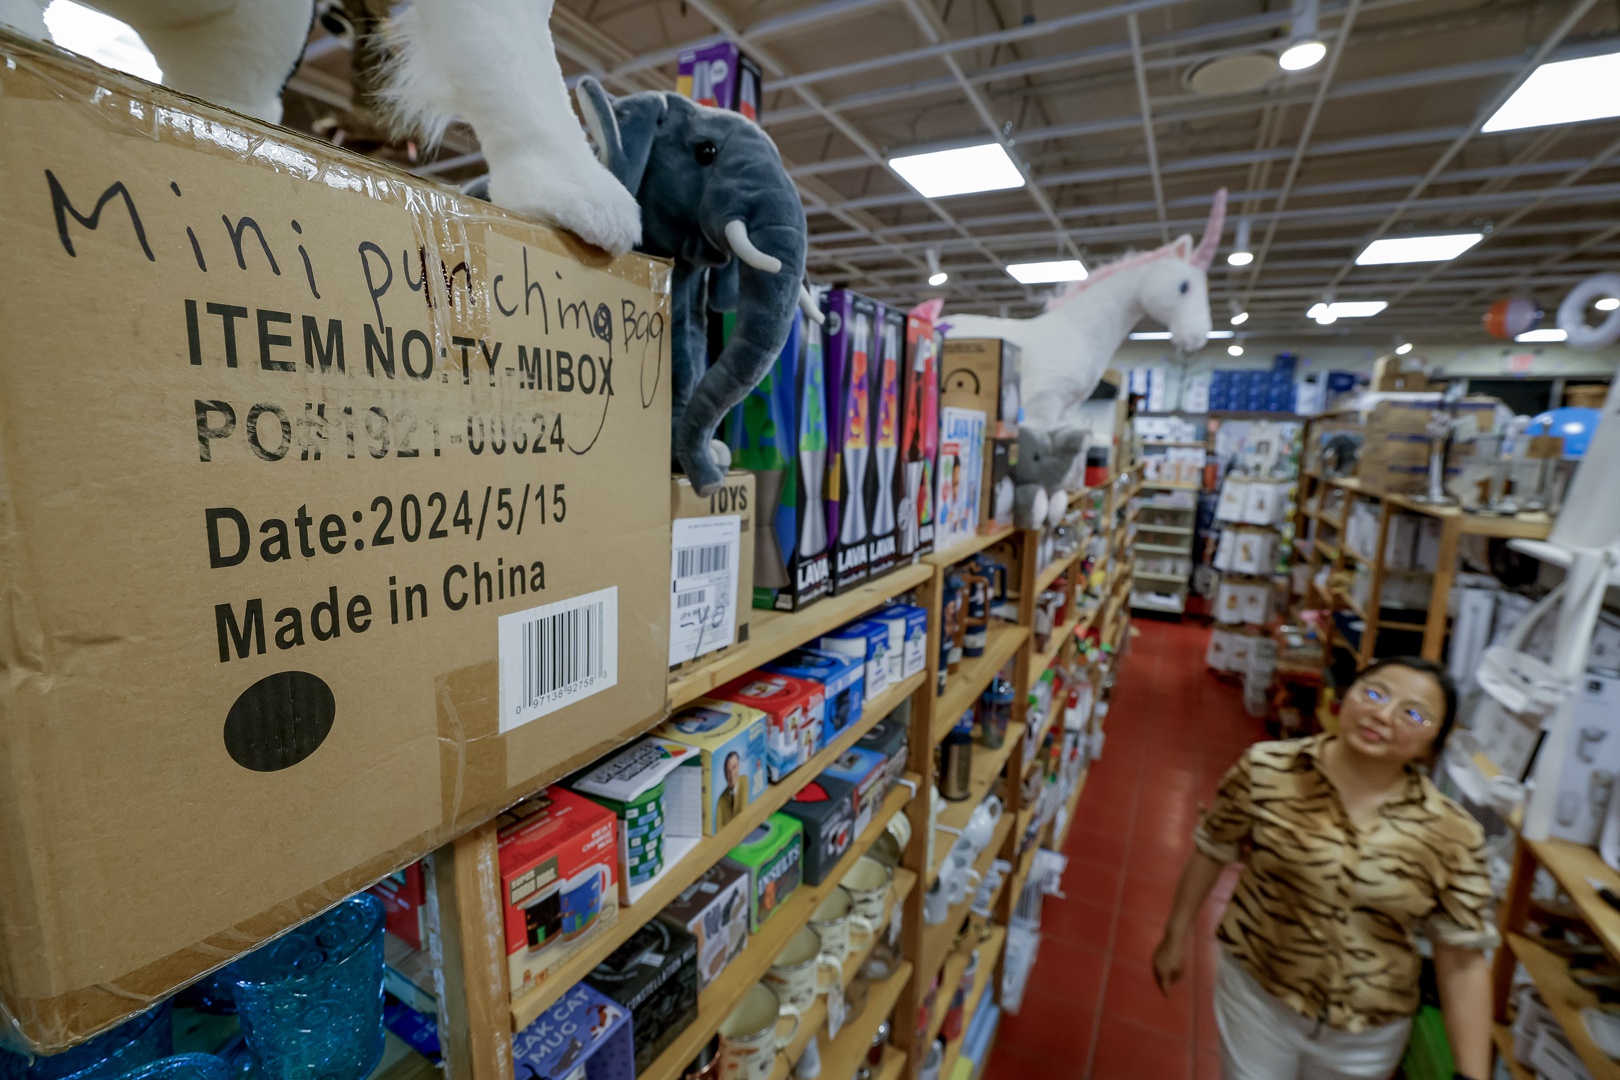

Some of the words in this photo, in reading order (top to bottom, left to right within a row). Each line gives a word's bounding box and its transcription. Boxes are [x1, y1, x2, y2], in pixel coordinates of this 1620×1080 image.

[45, 168, 320, 299] Mini
[184, 298, 346, 374] ITEM
[797, 557, 830, 591] LAVA
[837, 543, 868, 573] LAVA
[214, 585, 373, 664] Made
[388, 575, 429, 625] in
[442, 557, 547, 612] China
[512, 1020, 555, 1060] EAK
[552, 988, 589, 1021] CAT
[528, 1020, 578, 1064] MUG
